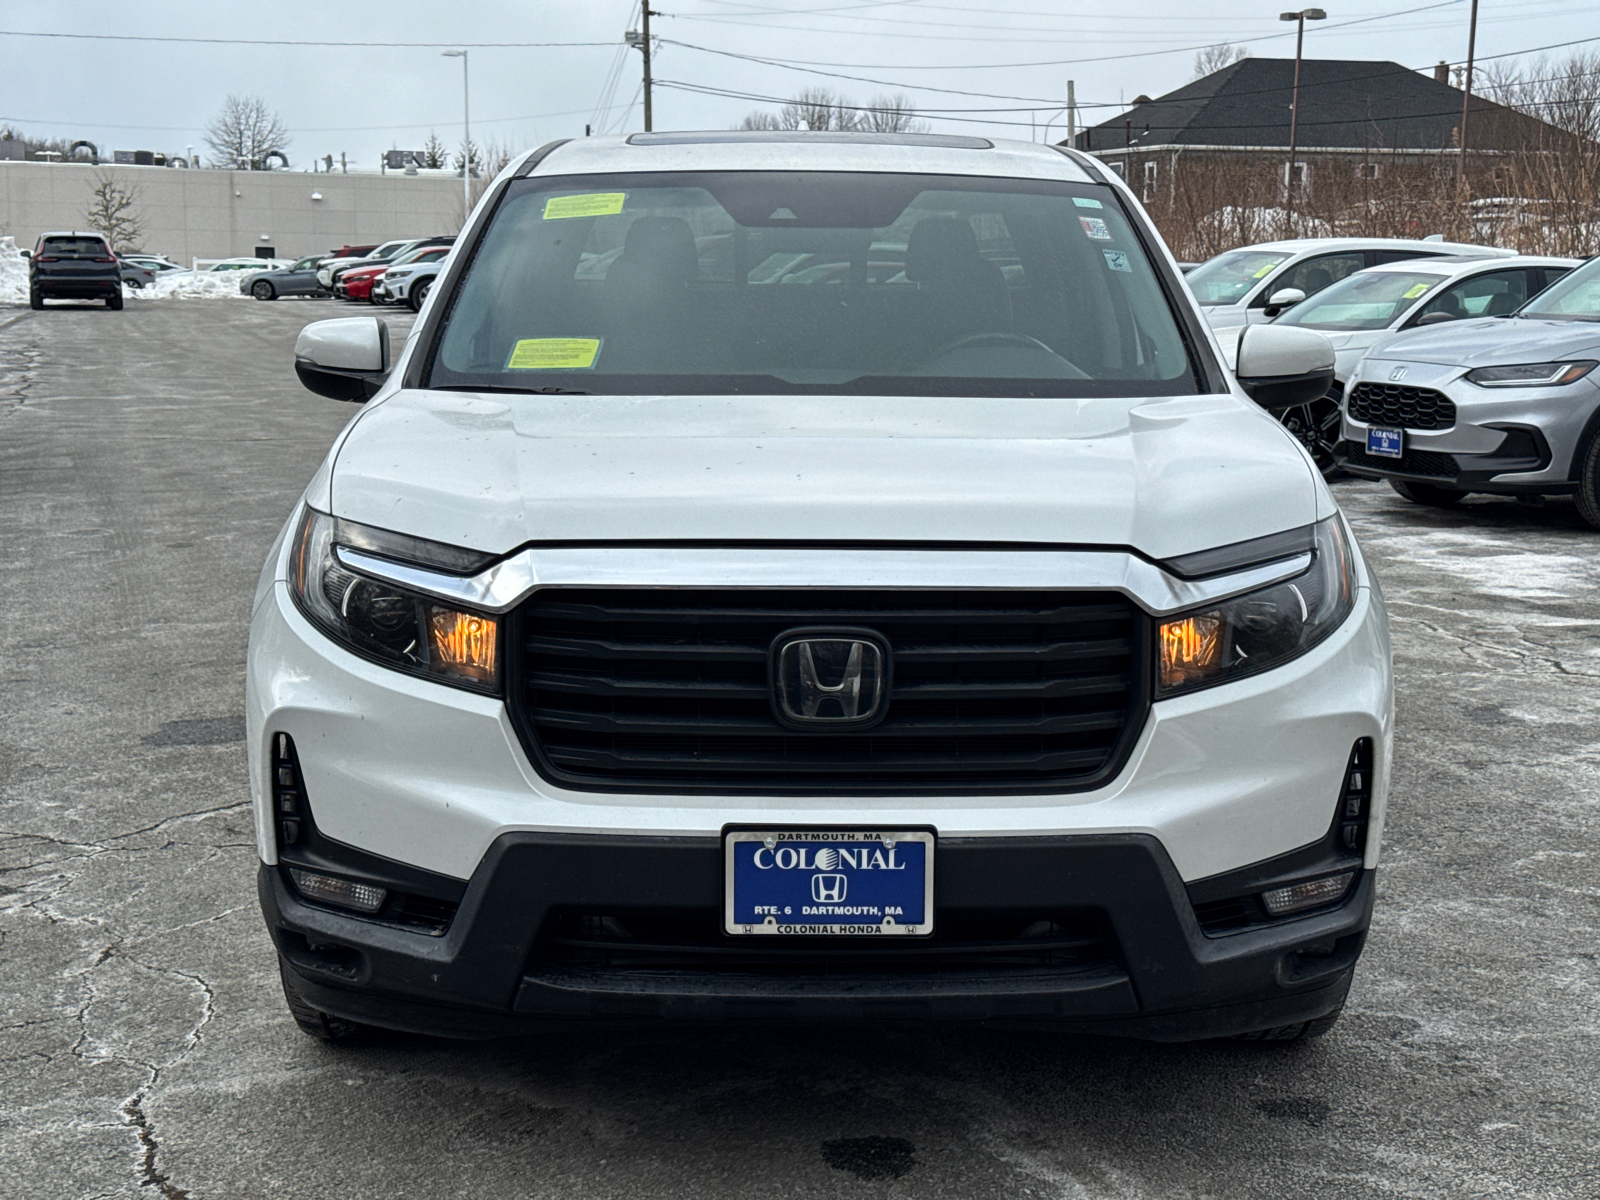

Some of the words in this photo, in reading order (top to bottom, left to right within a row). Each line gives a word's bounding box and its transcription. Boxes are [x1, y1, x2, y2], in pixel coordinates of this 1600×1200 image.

[777, 833, 860, 841] DARTMOUTH,
[863, 833, 882, 841] MA
[753, 847, 906, 871] COLONIAL
[754, 906, 781, 915] RTE.
[784, 906, 792, 915] 6
[802, 906, 882, 916] DARTMOUTH,
[885, 906, 903, 915] MA
[777, 925, 839, 934] COLONIAL
[839, 925, 882, 934] HONDA
